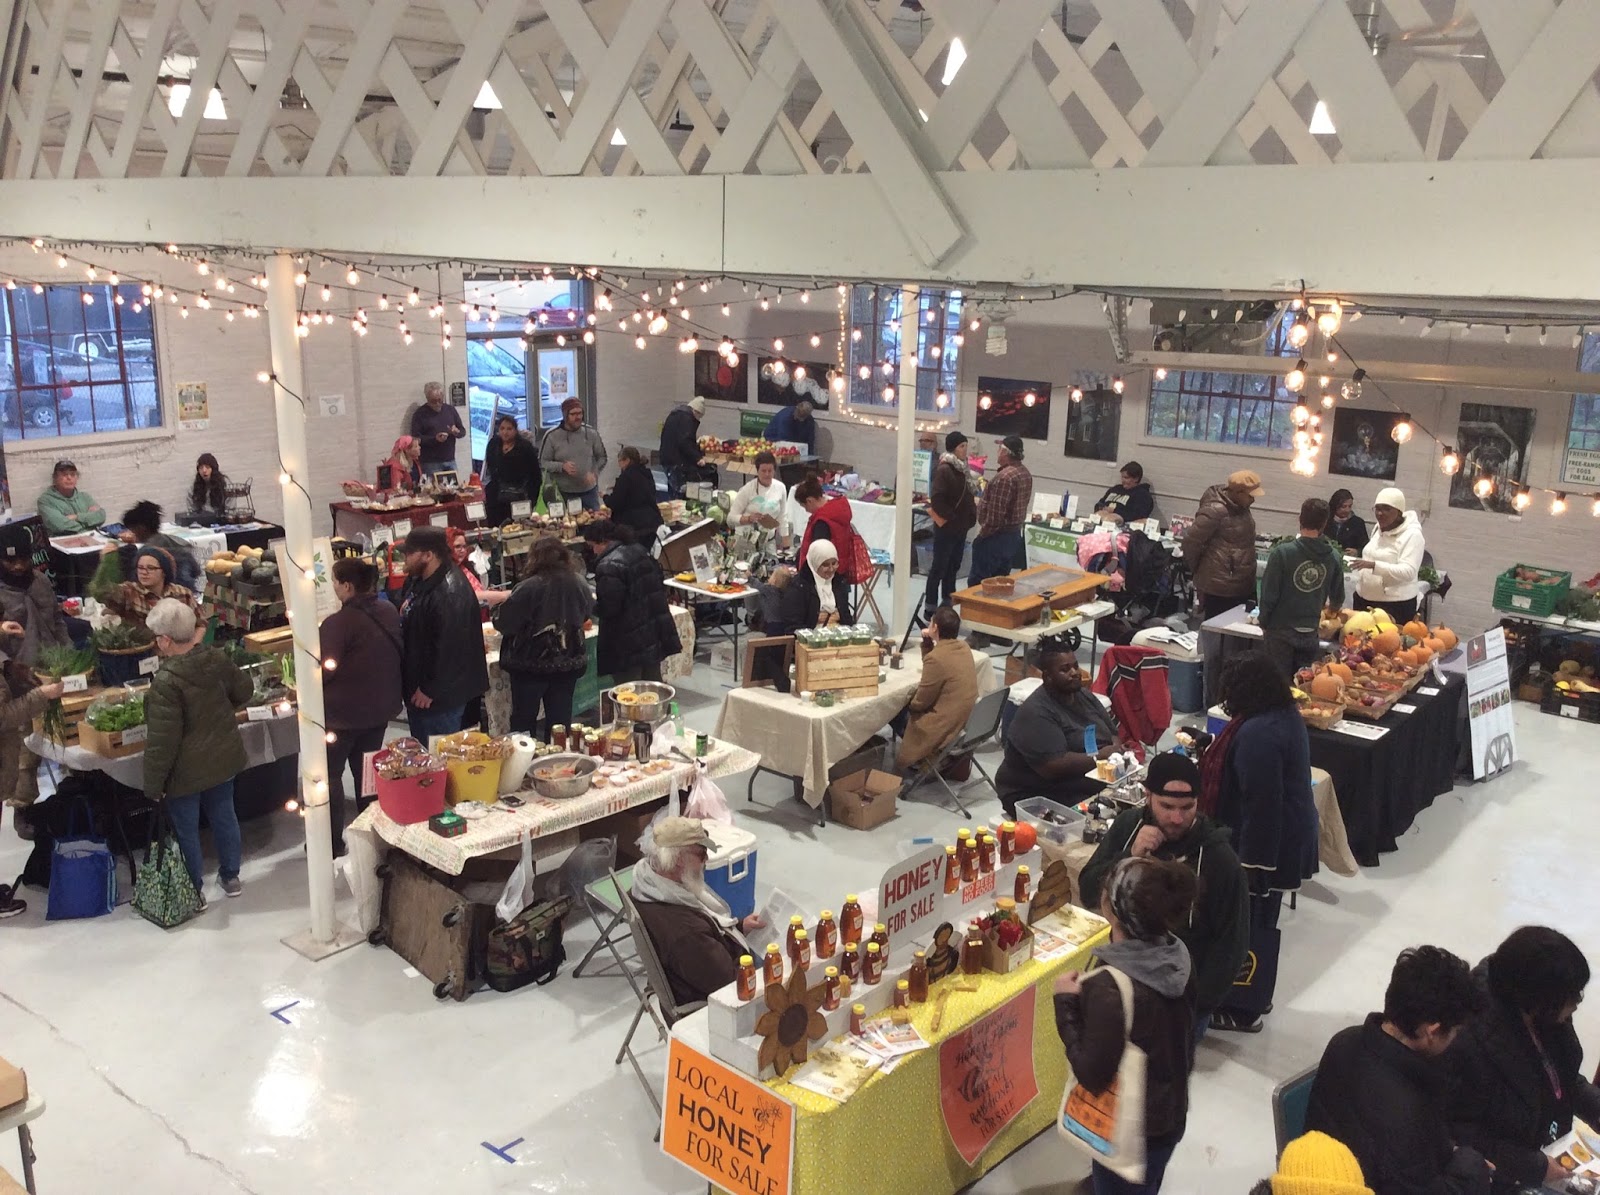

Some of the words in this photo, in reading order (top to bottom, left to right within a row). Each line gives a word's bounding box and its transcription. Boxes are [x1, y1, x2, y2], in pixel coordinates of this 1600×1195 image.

[884, 854, 943, 909] HONEY
[964, 884, 974, 896] NO
[975, 875, 994, 889] BEES
[964, 893, 974, 903] NO
[975, 883, 993, 896] FOOD
[887, 909, 907, 937] FOR
[910, 893, 935, 923] SALE
[675, 1057, 744, 1116] LOCAL
[678, 1093, 772, 1165] HONEY
[685, 1129, 724, 1174] FOR
[728, 1156, 779, 1195] SALE
